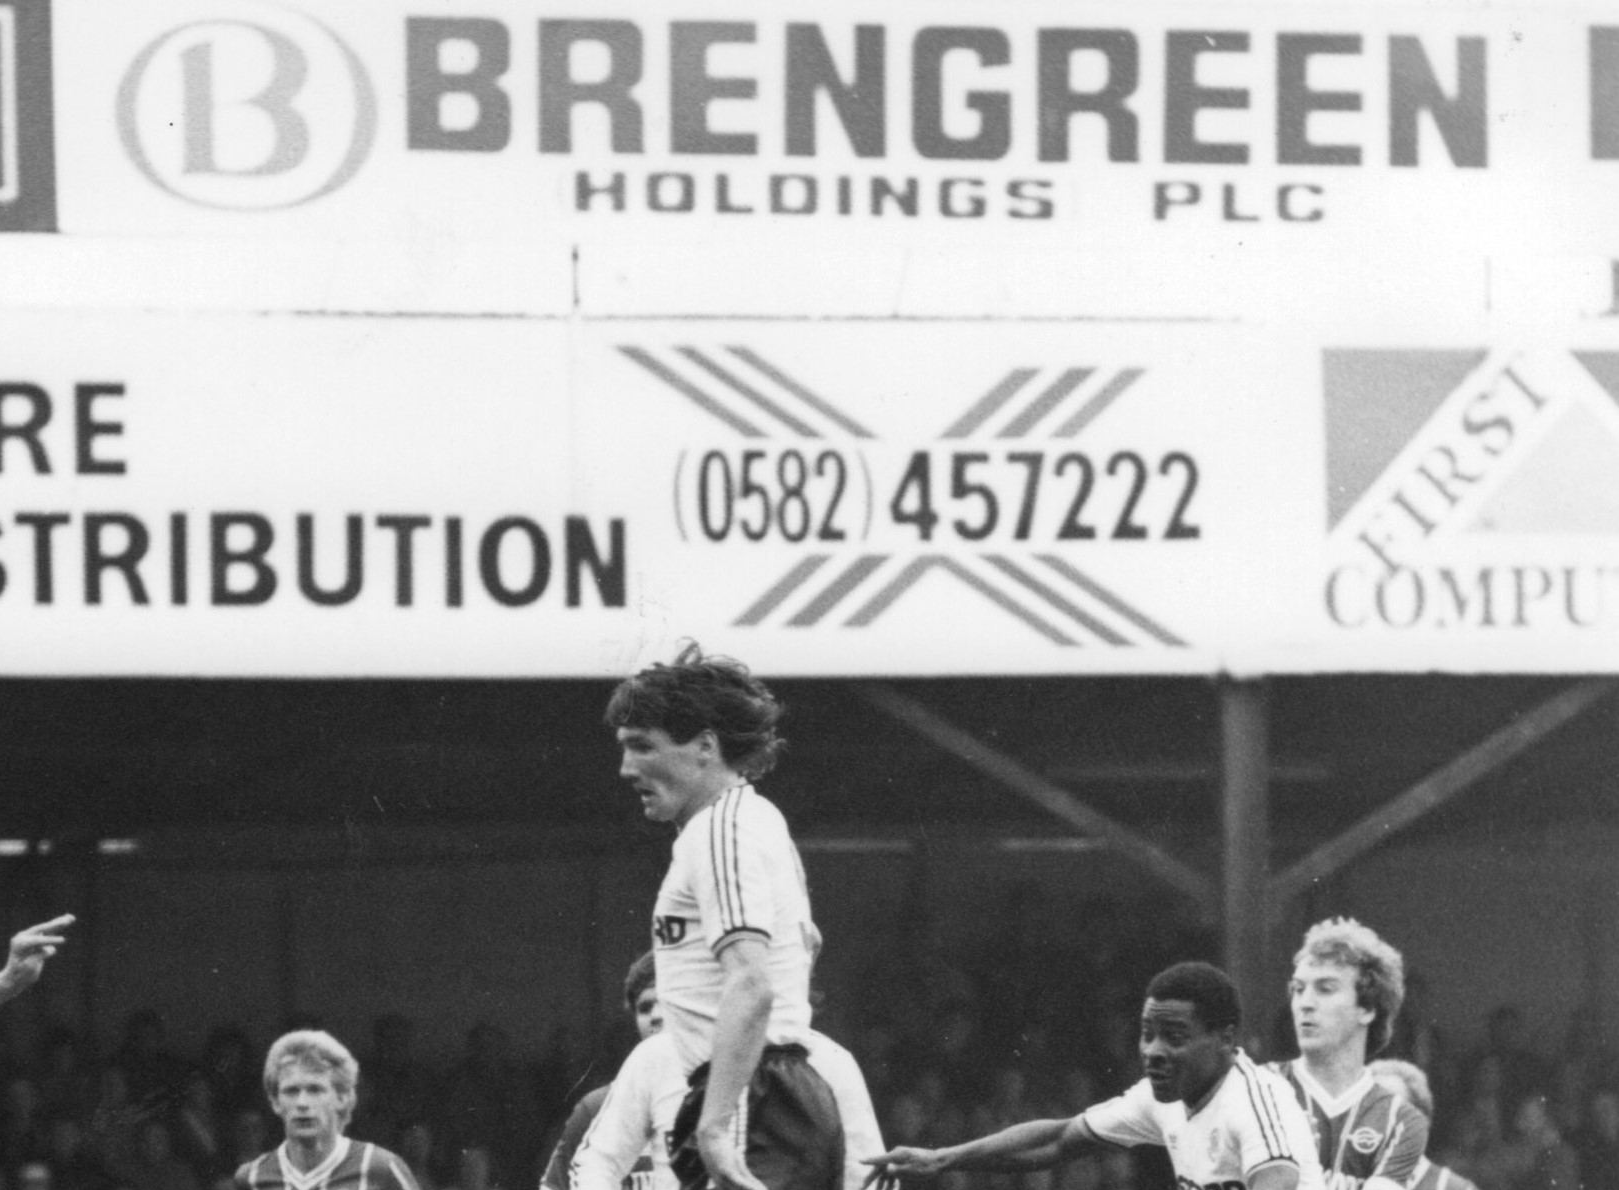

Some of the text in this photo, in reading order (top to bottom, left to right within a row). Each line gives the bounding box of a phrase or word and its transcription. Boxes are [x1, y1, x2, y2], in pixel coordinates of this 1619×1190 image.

[405, 16, 1488, 168] BRENGREEN
[574, 170, 1326, 223] HOLDINGS PLC
[889, 450, 1201, 542] 457222
[1323, 563, 1619, 629] COMPU
